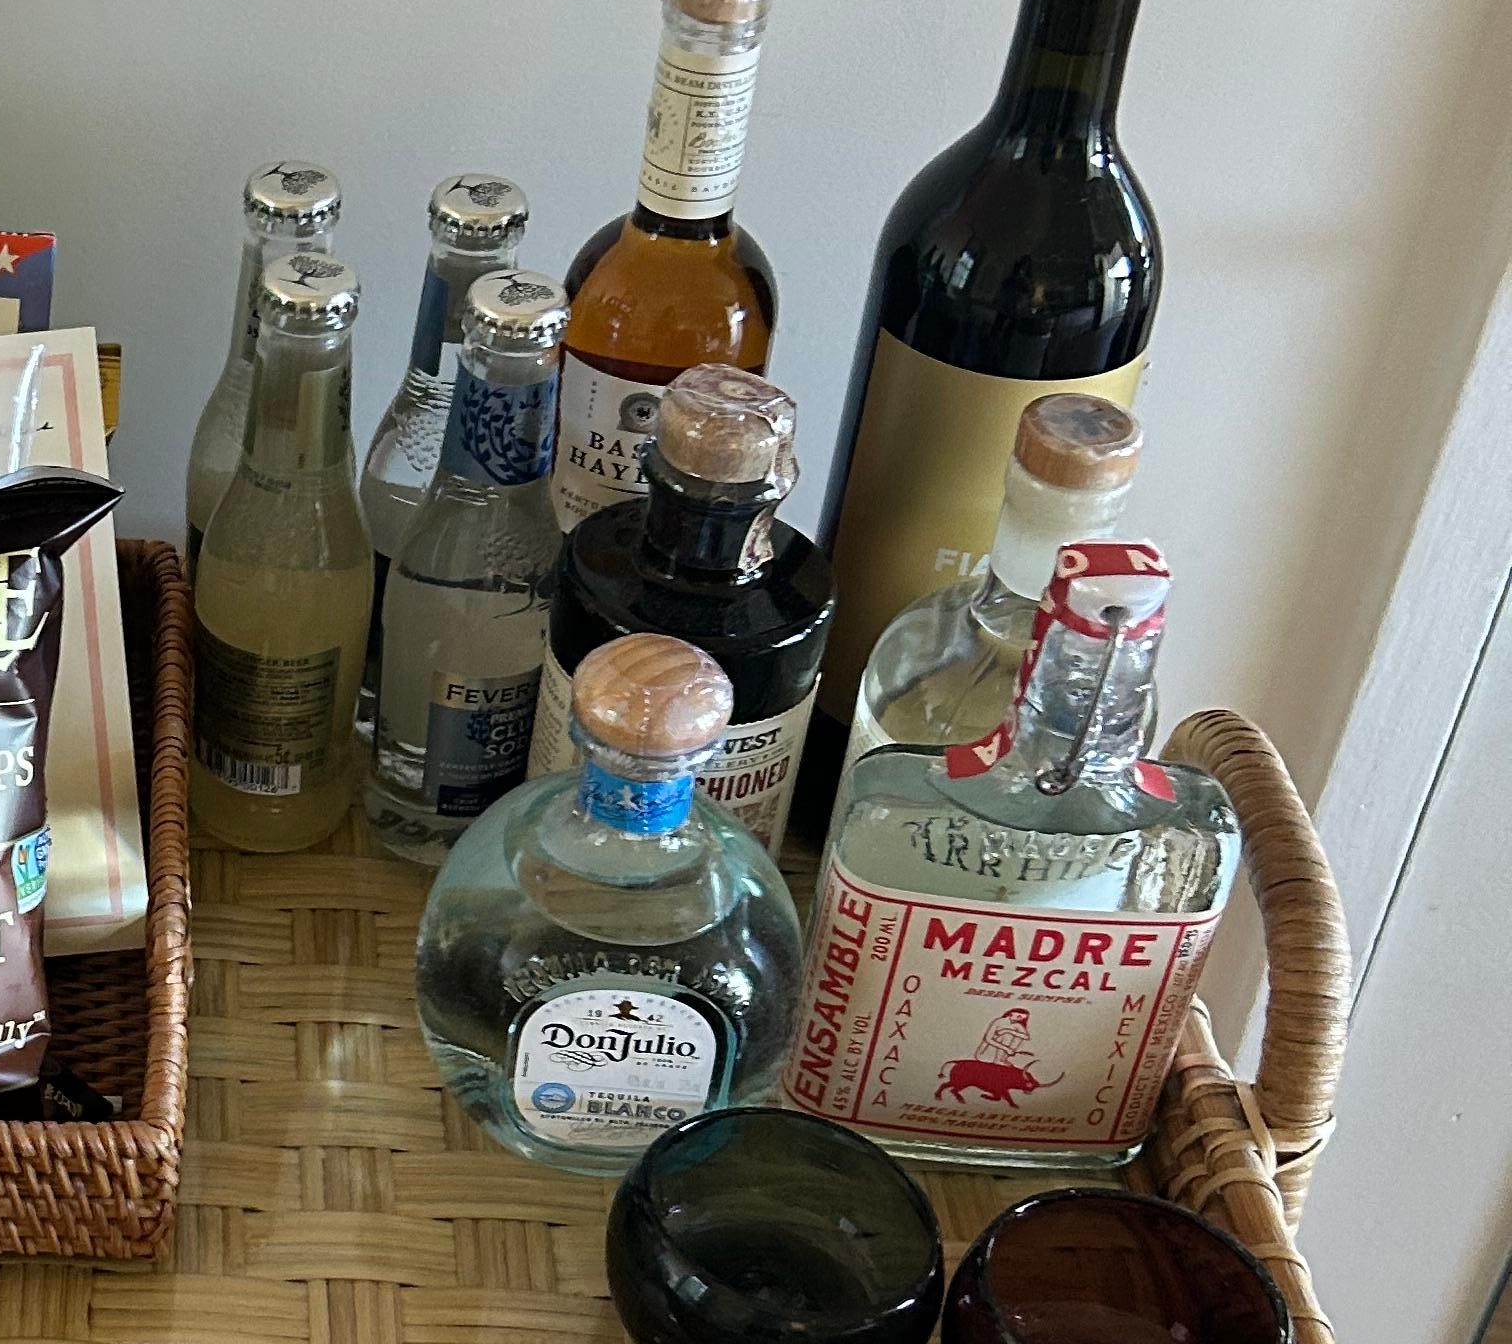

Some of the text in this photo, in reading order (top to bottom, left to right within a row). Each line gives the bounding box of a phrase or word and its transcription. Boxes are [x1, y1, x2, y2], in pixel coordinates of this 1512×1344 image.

[588, 430, 643, 460] BAS
[569, 445, 649, 485] HAY
[934, 549, 993, 578] FIA
[695, 754, 792, 802] HIONED
[923, 917, 1159, 968] MADRE
[940, 958, 1118, 992] MEZCAL
[793, 889, 874, 1108] ENSAMBLE
[587, 1009, 665, 1023] 19 42
[852, 1012, 873, 1036] VOL
[1149, 993, 1178, 1046] MEXICO
[848, 1038, 864, 1057] BY
[871, 973, 922, 1108] OAXACA
[840, 1058, 860, 1084] ALC
[1087, 993, 1146, 1127] MEXICO
[586, 1100, 688, 1122] BLANCO
[587, 1090, 651, 1104] TEQUILA
